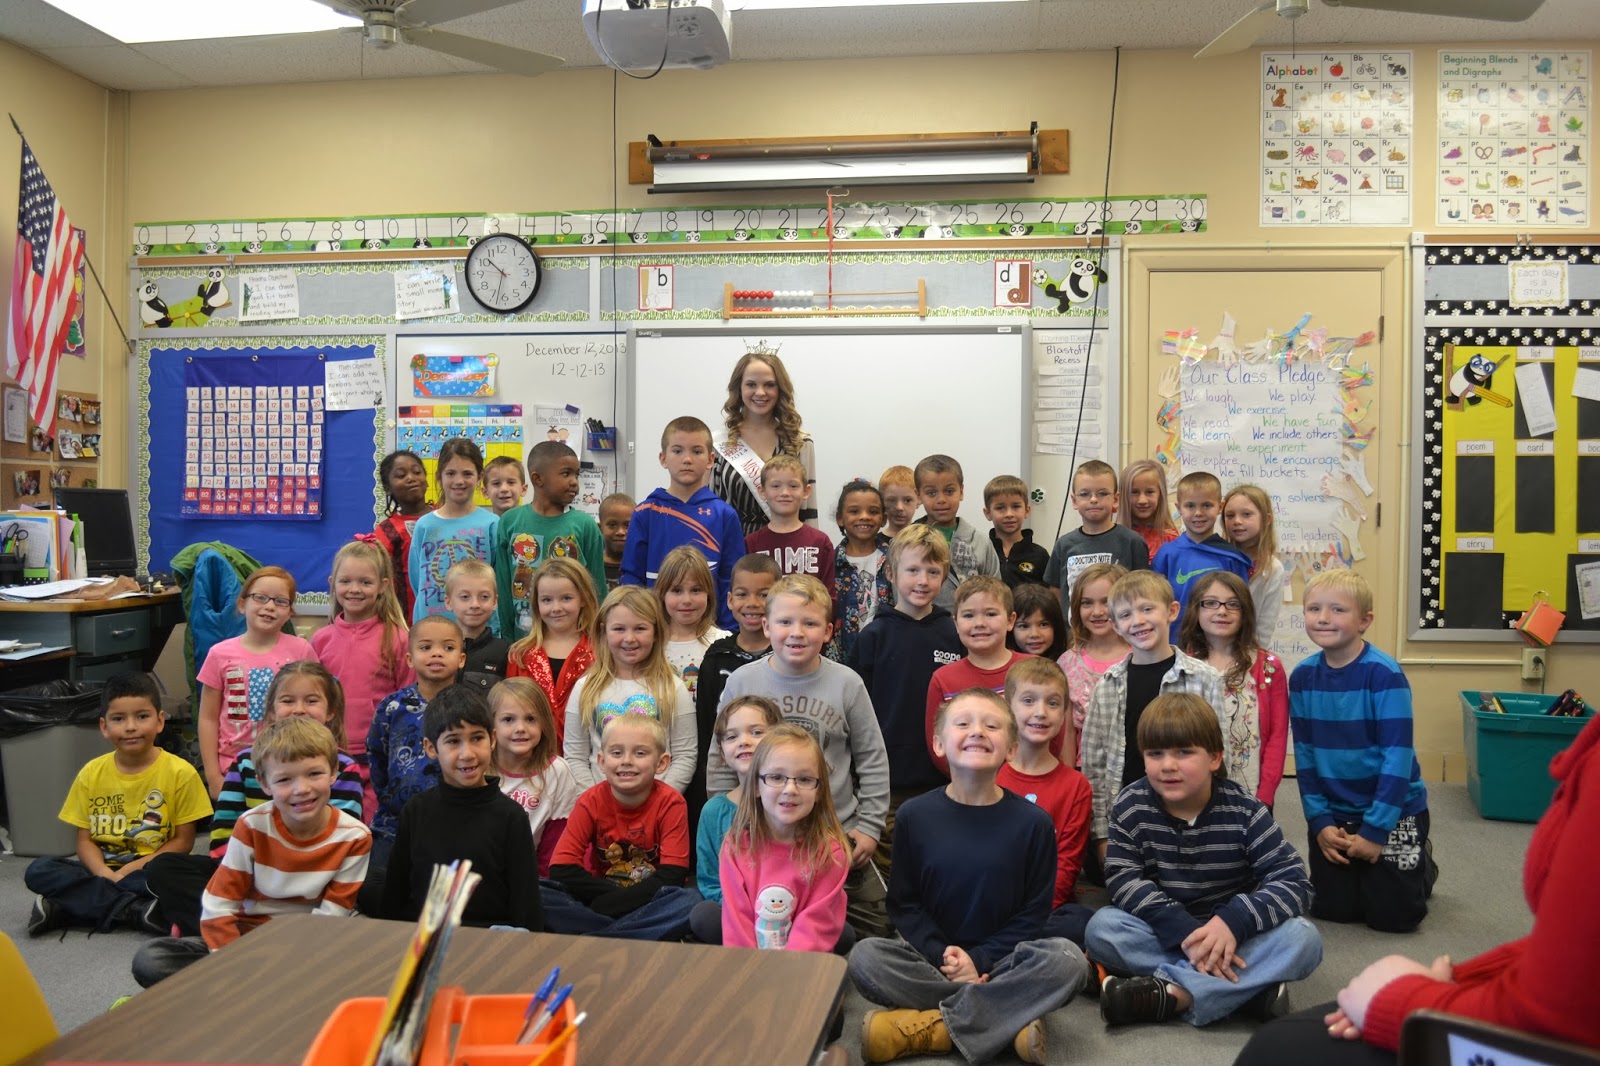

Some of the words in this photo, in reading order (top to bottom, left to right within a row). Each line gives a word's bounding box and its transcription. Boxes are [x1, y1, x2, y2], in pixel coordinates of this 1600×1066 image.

[1444, 54, 1487, 66] Beginning
[1488, 54, 1518, 64] Blends
[1266, 65, 1318, 79] Alphabet
[1444, 68, 1460, 76] and
[1462, 68, 1502, 78] Digraphs
[1352, 83, 1364, 92] Gg
[1323, 140, 1333, 148] Pp
[138, 225, 150, 246] 0
[185, 224, 196, 244] 2
[209, 224, 220, 244] 3
[232, 222, 243, 244] 4
[256, 222, 268, 242] 5
[280, 222, 292, 241] 6
[306, 221, 316, 240] 7
[331, 220, 342, 241] 8
[354, 220, 366, 240] 9
[381, 219, 400, 240] 10
[414, 218, 428, 239] 11
[450, 216, 468, 238] 12
[518, 216, 536, 236] 14
[554, 215, 572, 235] 15
[590, 214, 608, 234] 16
[624, 212, 642, 233] 17
[660, 210, 678, 232] 18
[696, 210, 714, 231] 19
[734, 209, 761, 231] 20
[778, 208, 798, 230] 21
[818, 206, 846, 229] 22
[950, 204, 978, 226] 25
[994, 203, 1024, 225] 26
[1040, 202, 1069, 224] 27
[1084, 201, 1114, 223] 28
[1129, 200, 1158, 222] 29
[1174, 198, 1205, 221] 30
[488, 249, 495, 258] 11
[496, 244, 507, 254] 12
[480, 258, 490, 267] 10
[518, 256, 526, 266] 2
[476, 270, 485, 279] 9
[523, 268, 530, 278] 3
[658, 268, 668, 286] b
[1000, 263, 1010, 283] d
[1518, 268, 1538, 278] Each
[1542, 268, 1559, 279] day
[480, 281, 489, 290] 8
[520, 280, 528, 289] 4
[490, 290, 497, 298] 7
[501, 292, 509, 302] 6
[512, 288, 520, 298] 5
[526, 342, 580, 356] December
[1046, 344, 1090, 355] Blastoff
[1530, 348, 1542, 357] list
[1054, 355, 1081, 364] Recess
[418, 370, 490, 382] December
[1190, 364, 1219, 384] Our
[1226, 362, 1267, 384] Class
[1278, 364, 1326, 392] Pledge
[1184, 390, 1196, 402] We
[1268, 388, 1285, 402] We
[1228, 402, 1242, 415] We
[1184, 418, 1196, 428] We
[1262, 416, 1278, 427] We
[1284, 416, 1310, 427] have
[1182, 428, 1196, 440] We
[1252, 427, 1265, 440] We
[1270, 427, 1301, 440] include
[1227, 440, 1242, 452] We
[1466, 442, 1486, 452] poem
[1527, 442, 1544, 452] card
[1182, 454, 1196, 466] We
[1263, 452, 1278, 465] We
[1220, 466, 1235, 478] We
[1240, 464, 1254, 478] fill
[1260, 466, 1309, 478] buckets.
[1281, 532, 1296, 541] are
[1466, 538, 1486, 550] story
[1276, 620, 1284, 629] a
[1290, 640, 1309, 656] the
[88, 794, 125, 808] COME
[92, 807, 108, 815] AT
[110, 805, 124, 814] US
